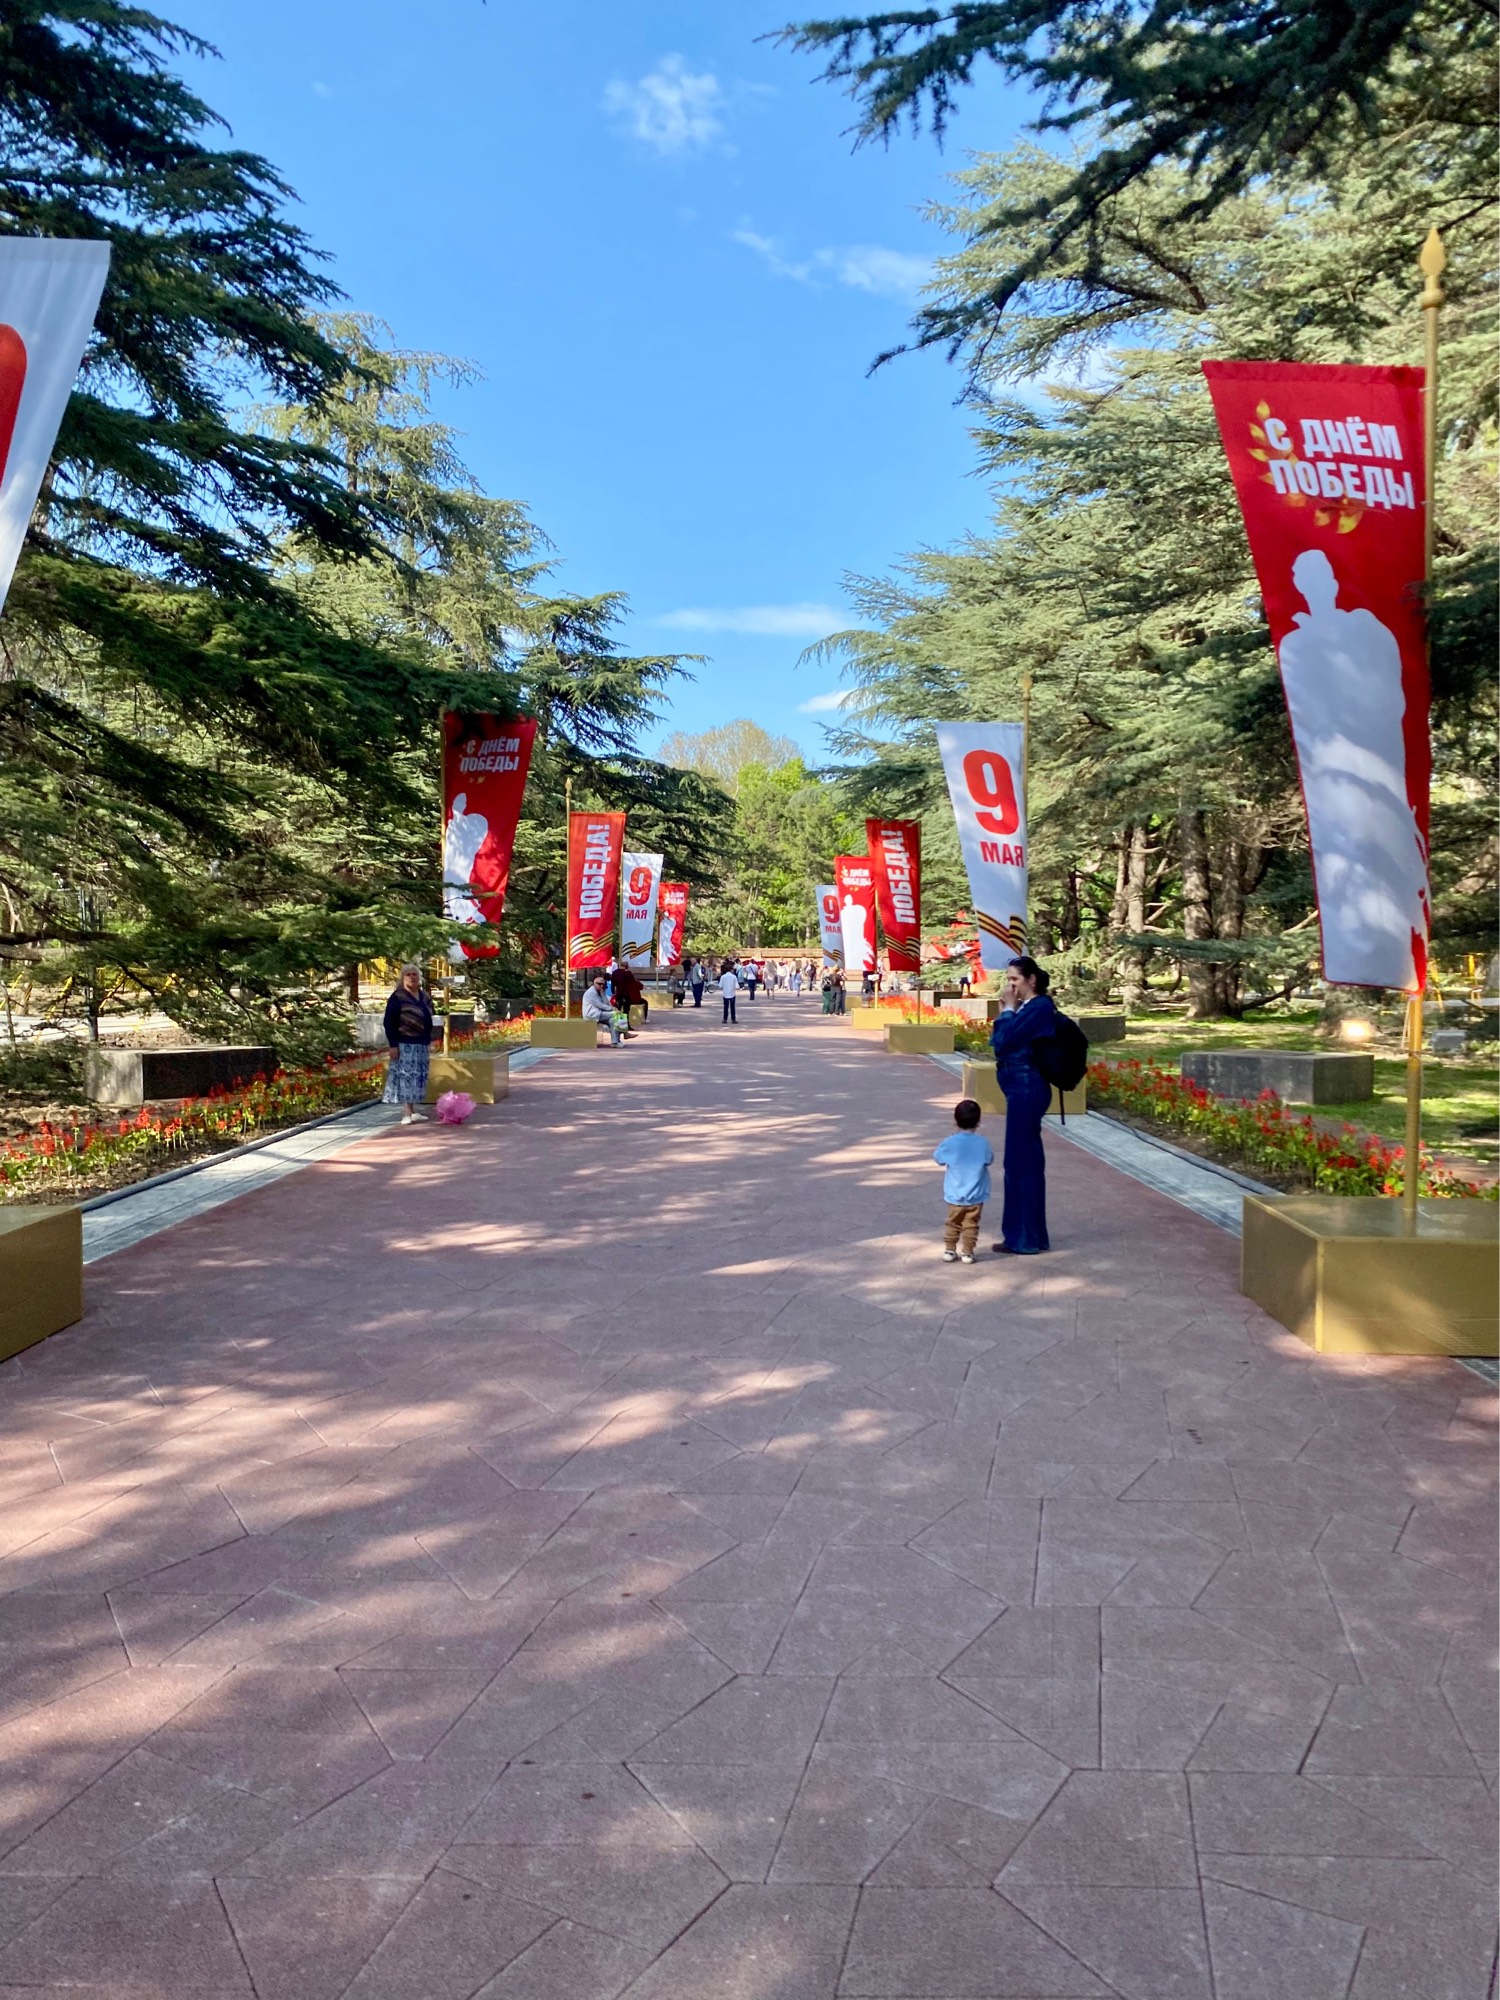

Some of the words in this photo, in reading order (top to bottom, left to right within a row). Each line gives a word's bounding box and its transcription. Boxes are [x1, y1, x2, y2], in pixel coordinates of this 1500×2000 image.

[1264, 418, 1292, 450] С
[1300, 416, 1403, 460] ДНЁМ
[1268, 459, 1415, 509] ПОБЕДЫ
[459, 755, 520, 773] ПОБЕДЫ
[466, 739, 476, 754] С
[477, 736, 520, 757] ДНЁМ
[963, 749, 1019, 835] 9
[579, 824, 612, 919] ПОБЕДА!
[979, 841, 1025, 868] МАЯ
[628, 866, 653, 906] 9
[880, 830, 916, 924] ПОБЕДА!
[626, 909, 648, 920] МАЯ
[823, 895, 840, 923] 9
